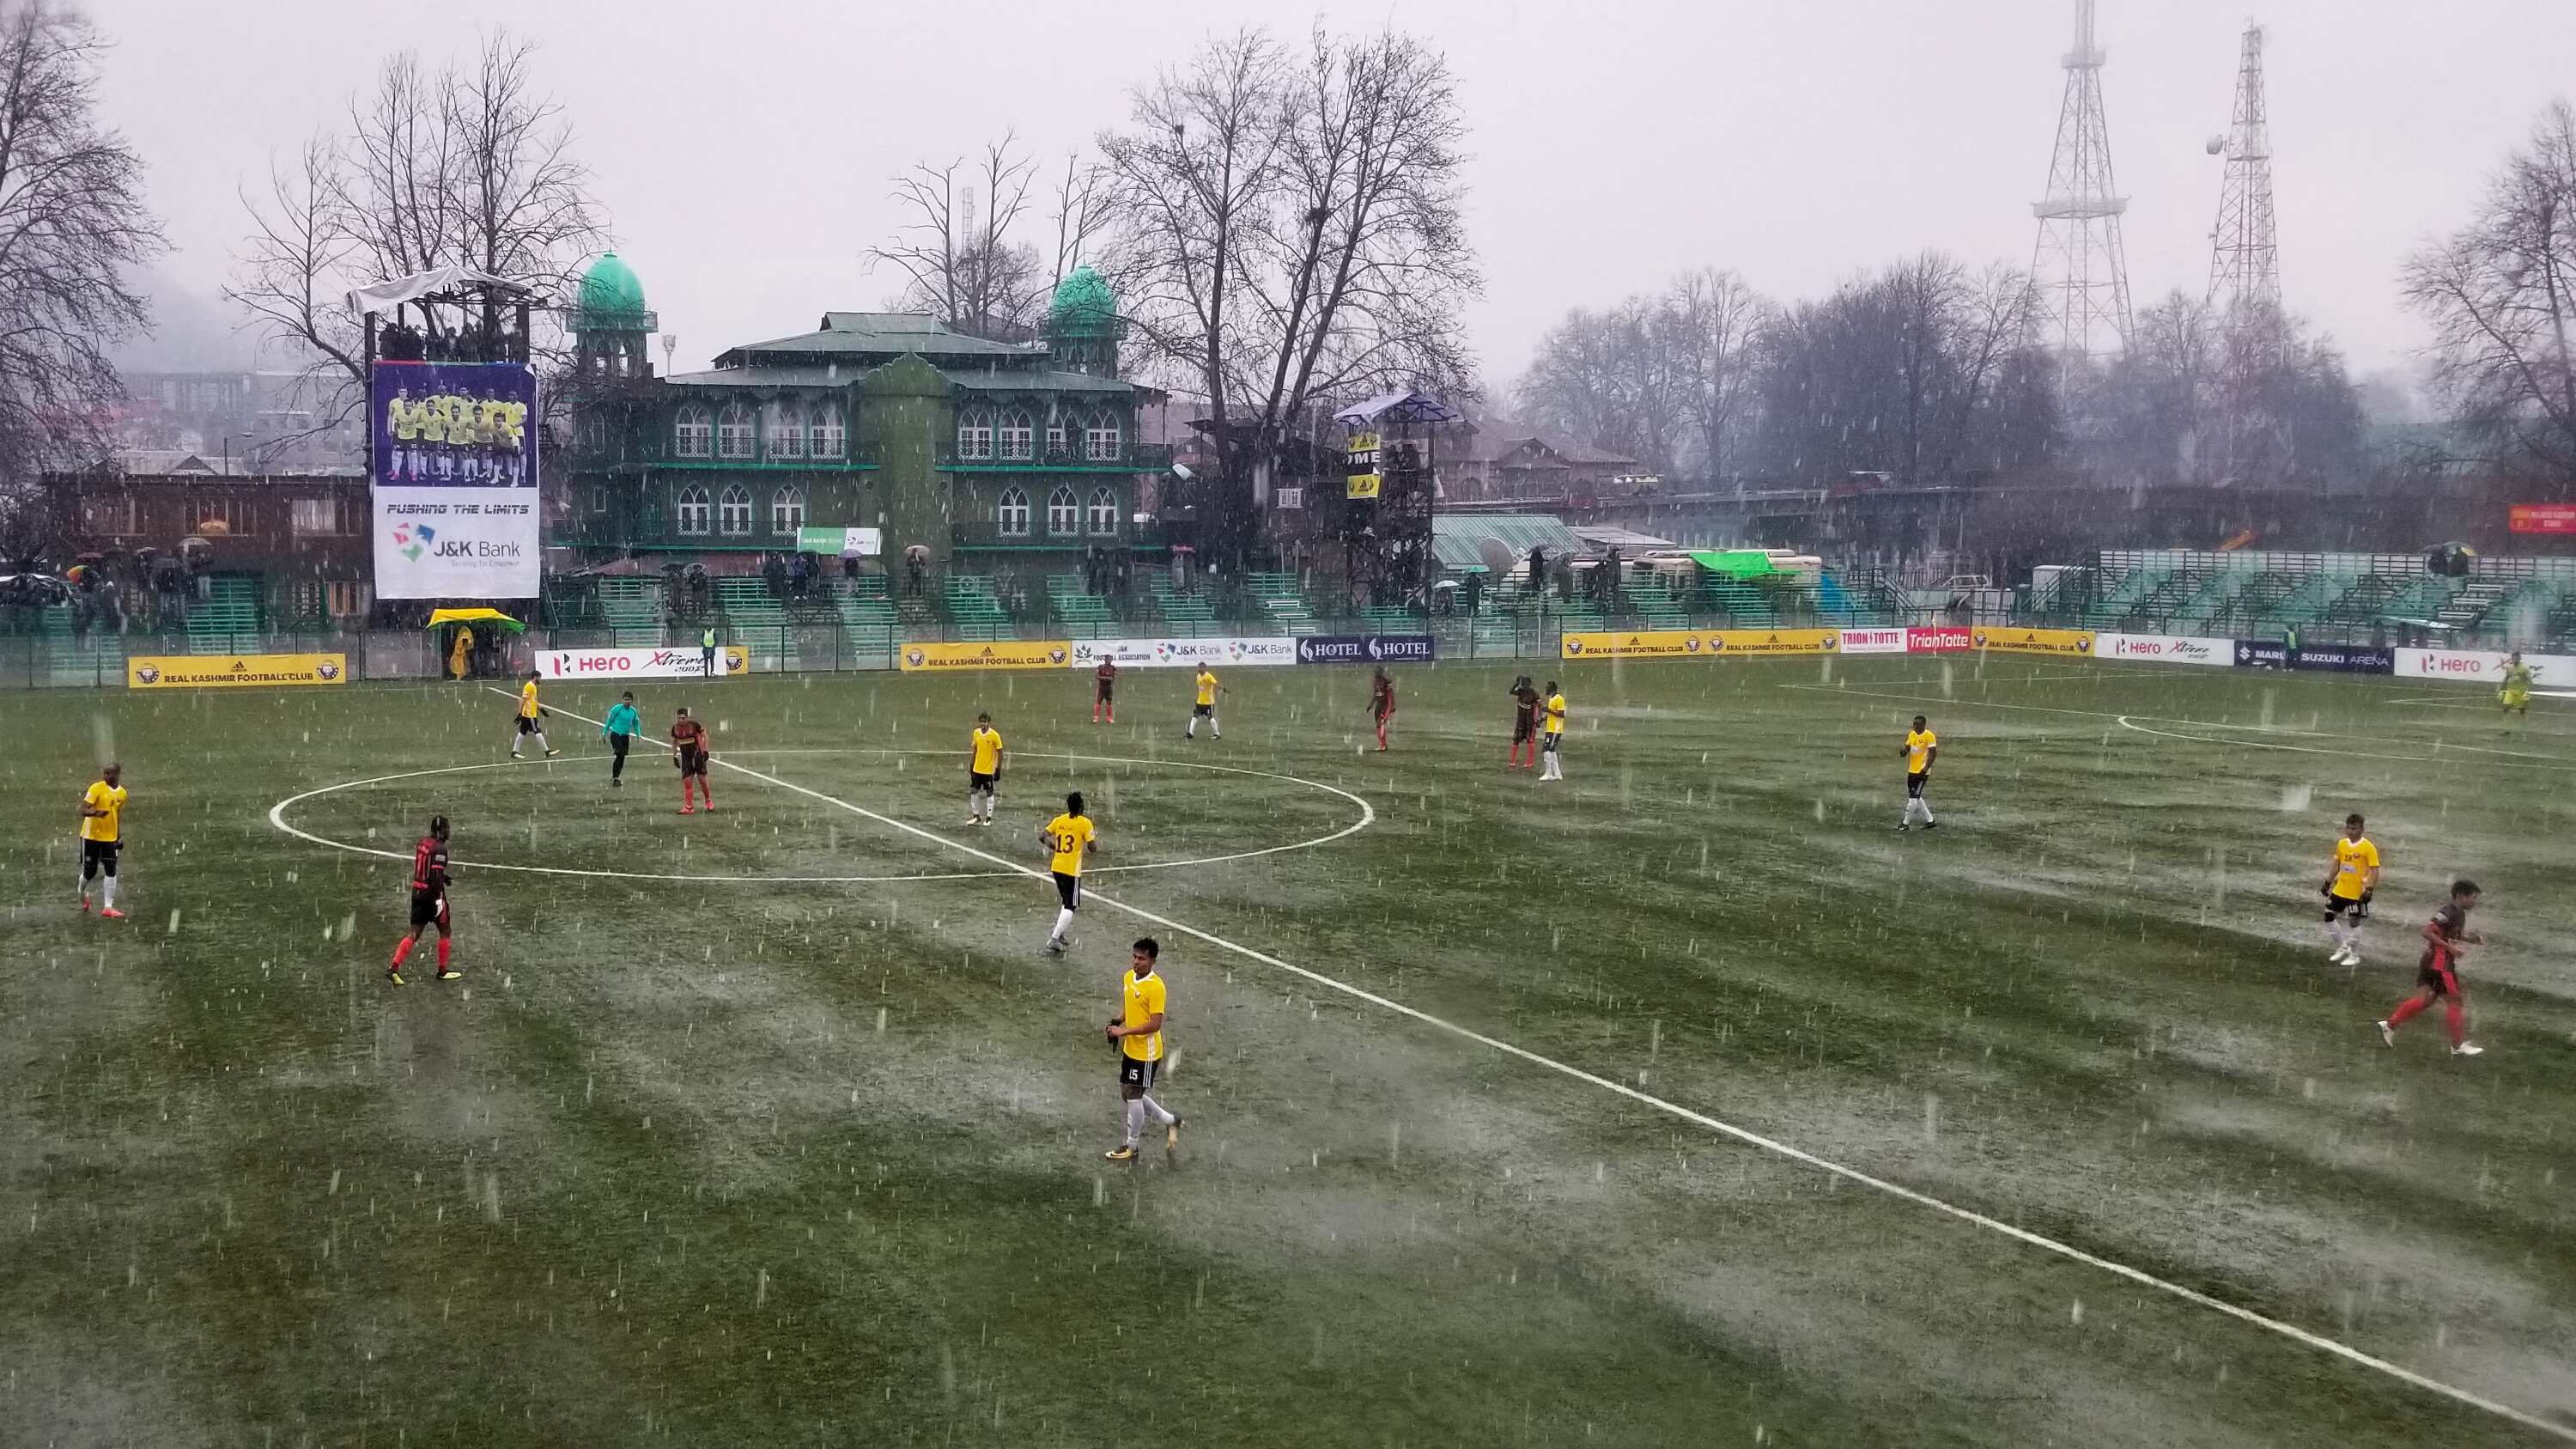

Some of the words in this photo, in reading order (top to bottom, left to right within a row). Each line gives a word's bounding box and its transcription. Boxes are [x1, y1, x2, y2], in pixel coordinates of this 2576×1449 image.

[387, 503, 447, 514] PUSHING
[453, 503, 480, 514] THE
[484, 503, 530, 514] LIMITS
[434, 541, 473, 557] J&K
[479, 541, 521, 557] Bank
[1842, 633, 1868, 645] TRION
[1874, 632, 1900, 644] TOTTE
[1176, 645, 1198, 655] J&K
[1200, 645, 1222, 654] Bank
[1249, 644, 1268, 654] J&K
[1271, 644, 1292, 654] Bank
[1315, 643, 1361, 656] HOTEL
[1383, 642, 1430, 654] HOTEL
[2301, 653, 2345, 663] SUZUKI
[2349, 656, 2388, 666] ARENA
[191, 674, 235, 683] KASHMIR
[237, 673, 289, 682] FOOTBALL
[289, 673, 313, 681] CLUB
[1056, 834, 1074, 854] 13
[1129, 1068, 1139, 1080] 15
